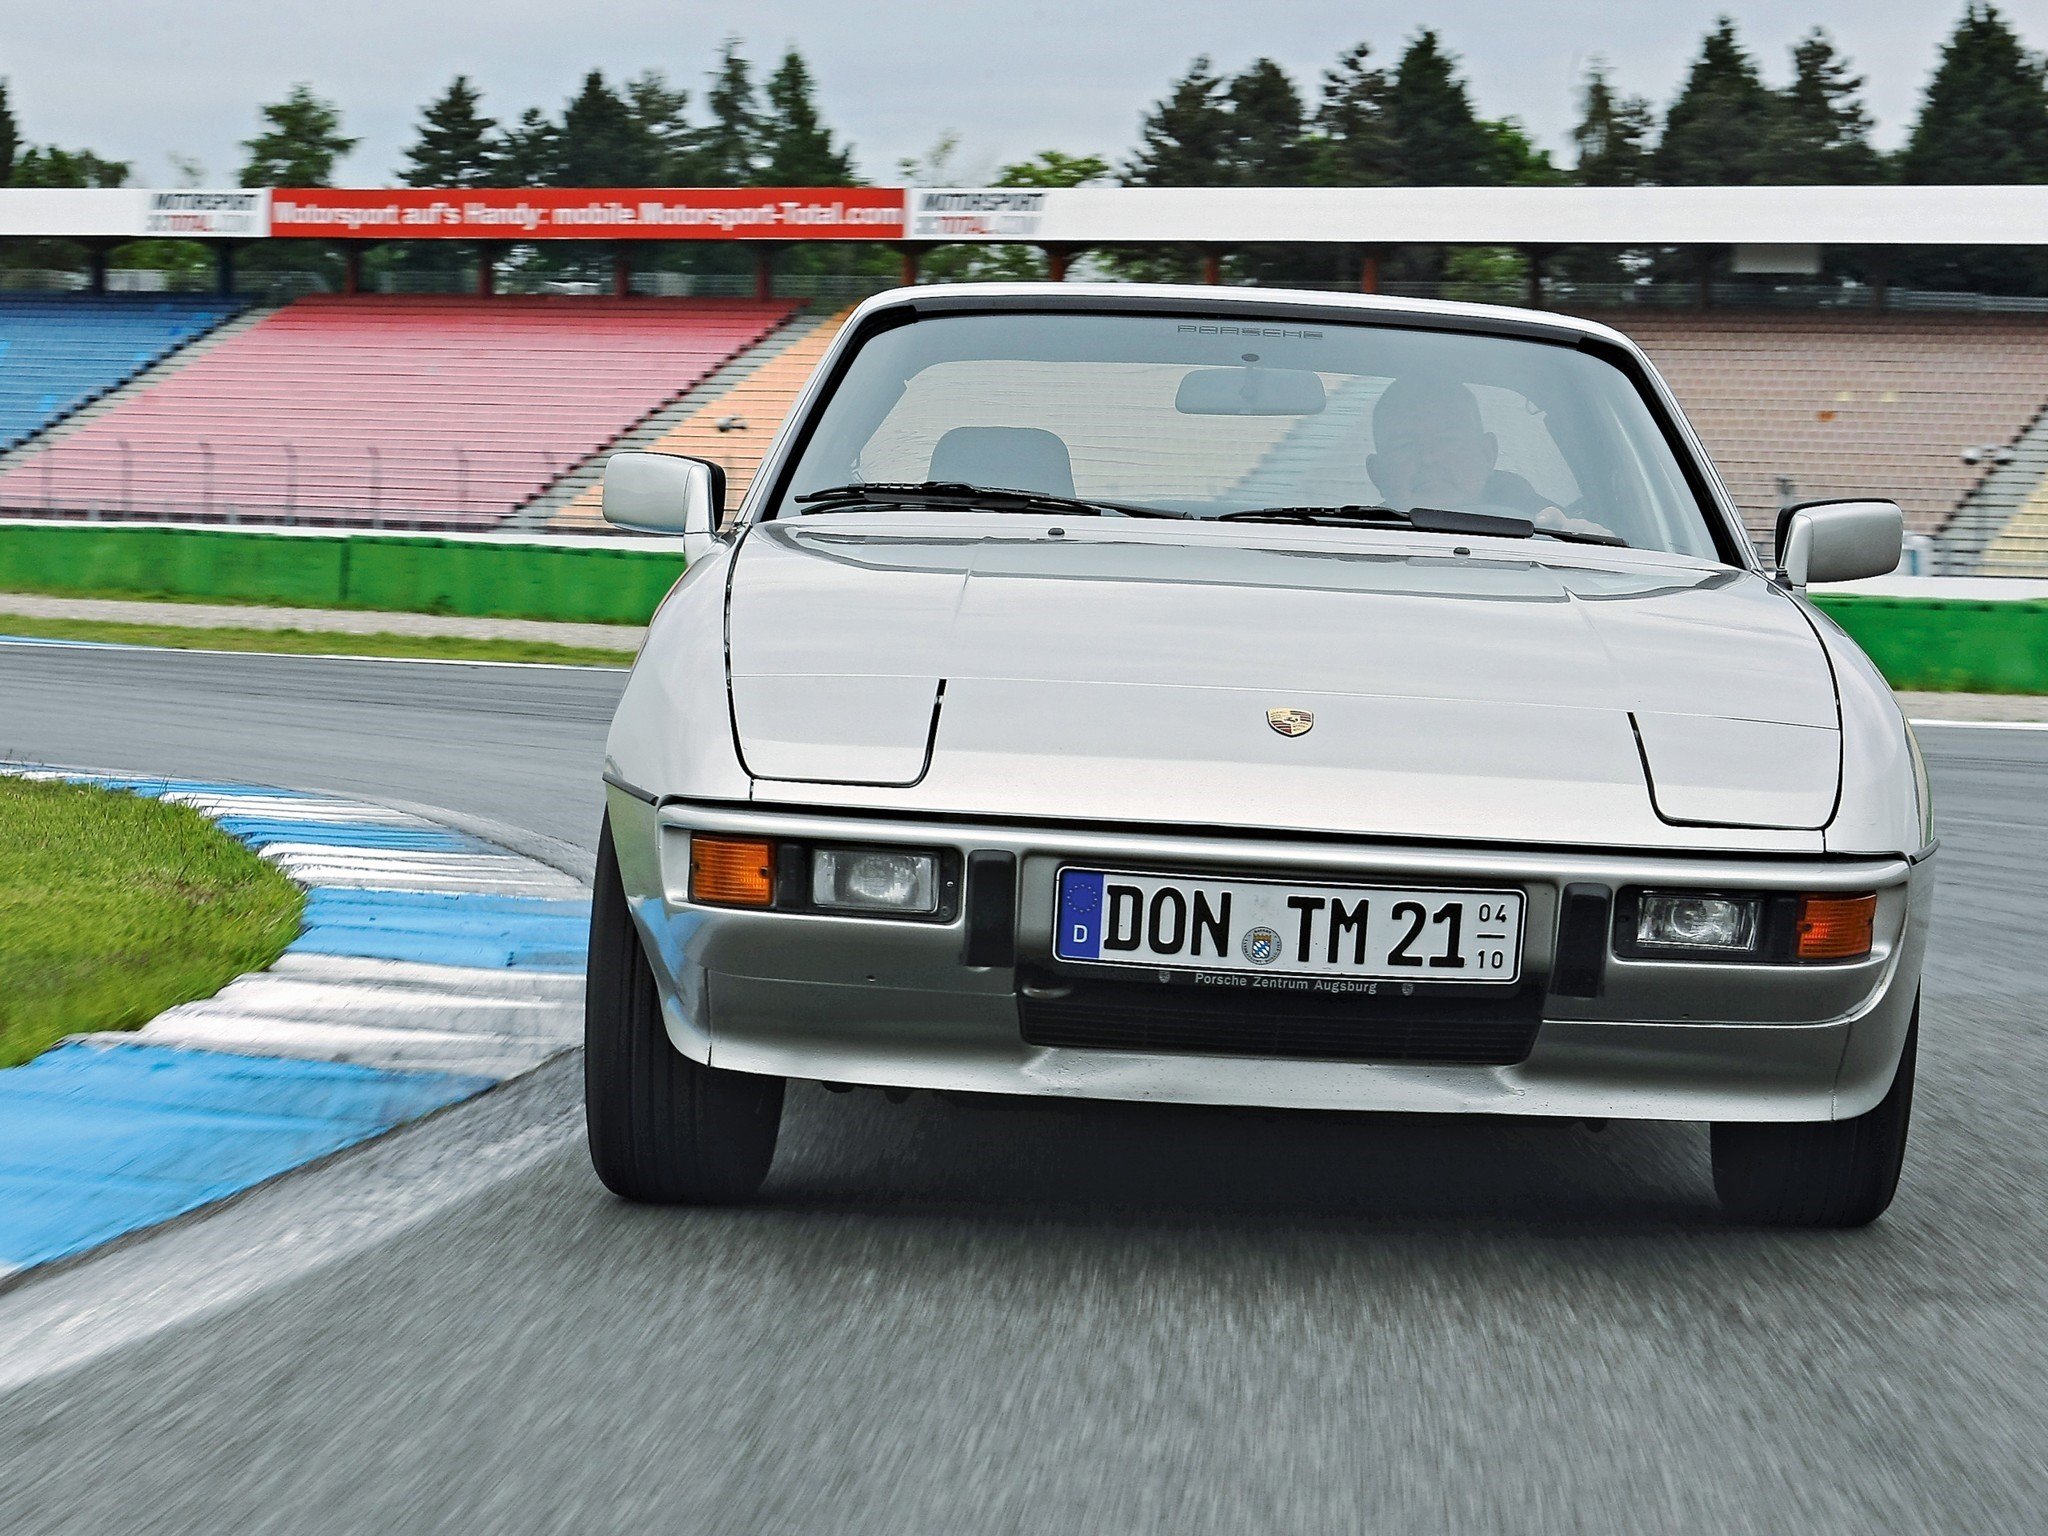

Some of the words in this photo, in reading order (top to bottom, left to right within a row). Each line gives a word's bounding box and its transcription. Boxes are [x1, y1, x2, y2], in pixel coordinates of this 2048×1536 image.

[273, 202, 399, 229] Motorsport
[1177, 325, 1323, 340] PORSCHE
[1478, 903, 1507, 924] 04
[1072, 924, 1088, 944] D
[1103, 884, 1232, 958] DON
[1287, 895, 1370, 965] TM
[1387, 901, 1465, 969] 21
[1477, 949, 1504, 969] 10
[1195, 973, 1247, 987] Porsche
[1253, 976, 1308, 990] Zentrum
[1314, 979, 1377, 995] Augsburg
